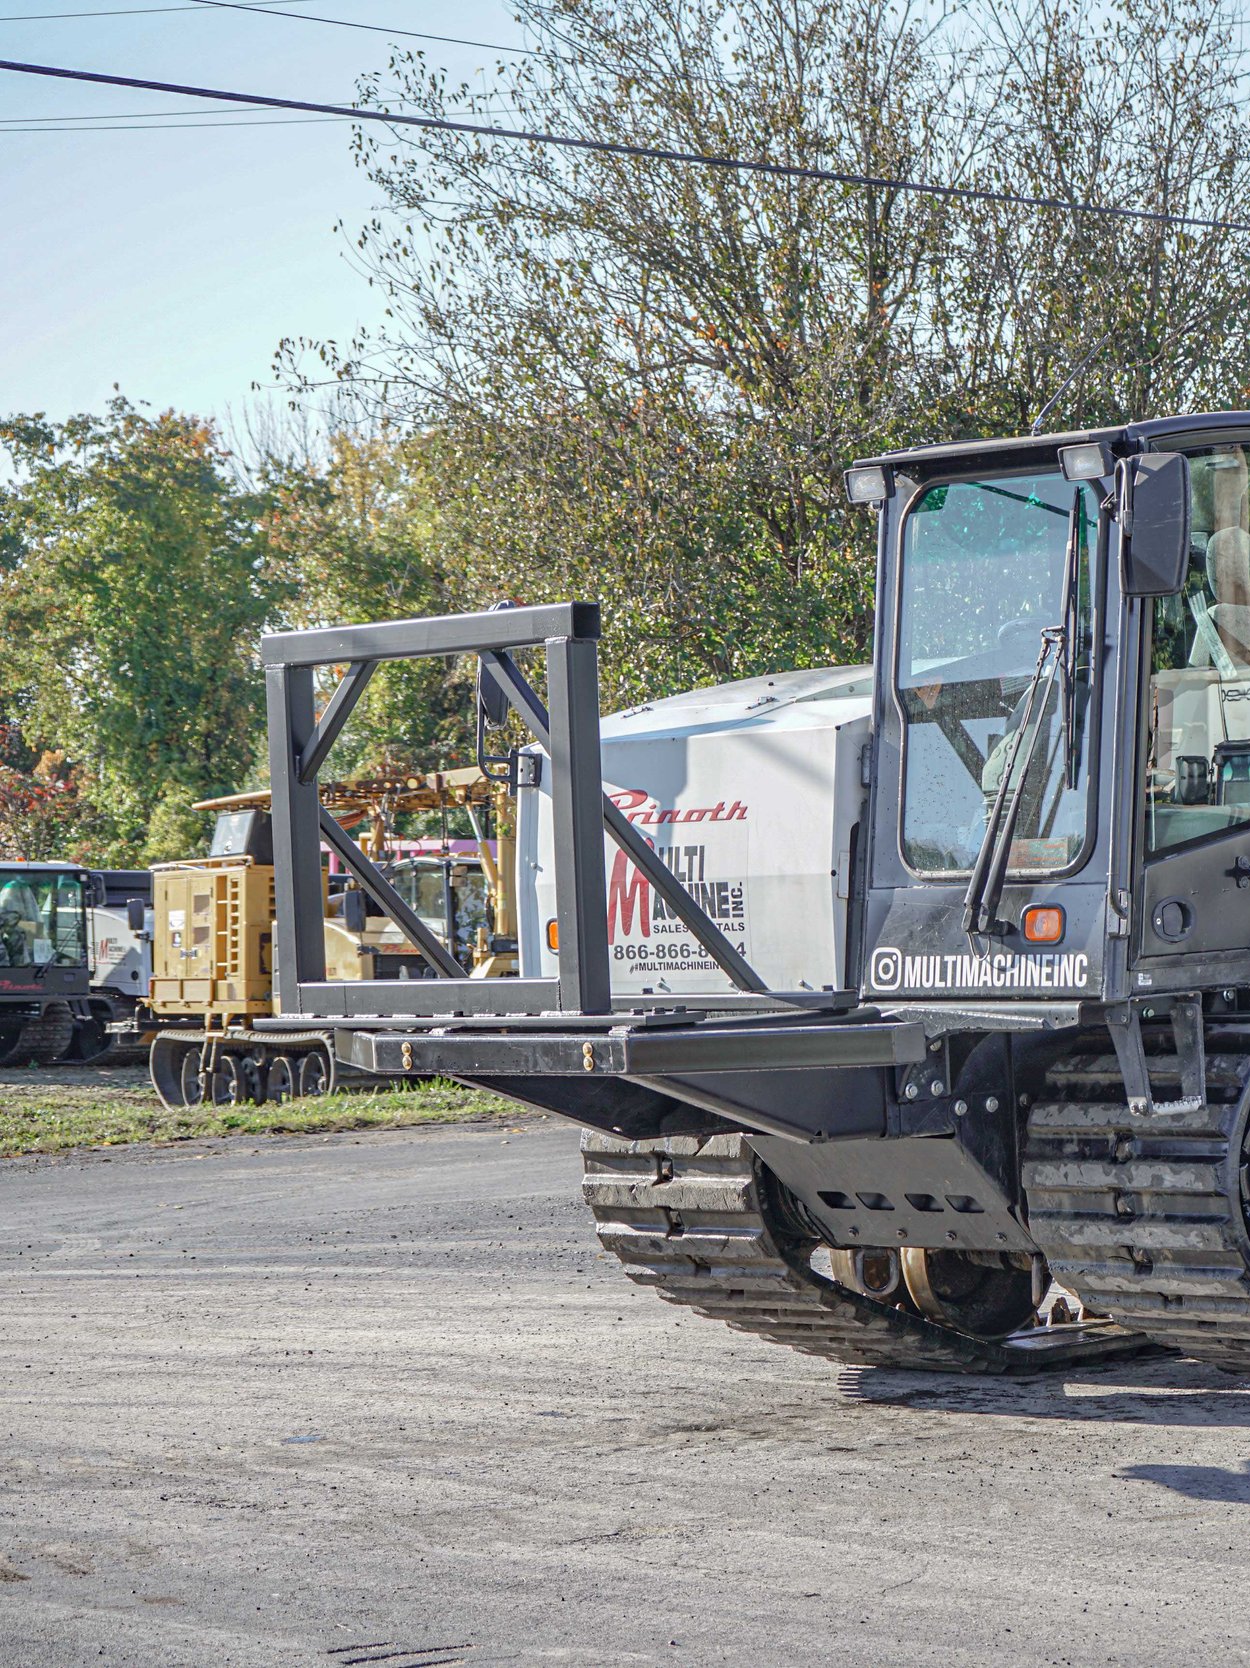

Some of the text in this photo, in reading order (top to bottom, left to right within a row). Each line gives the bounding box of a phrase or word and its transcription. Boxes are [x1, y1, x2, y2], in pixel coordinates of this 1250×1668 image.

[608, 789, 748, 824] Prinoth
[731, 881, 744, 918] INC.
[614, 942, 747, 960] 866-866-84
[634, 961, 720, 971] #MULTIMACHINEIN
[904, 954, 1088, 988] MULTIMACHINEINC
